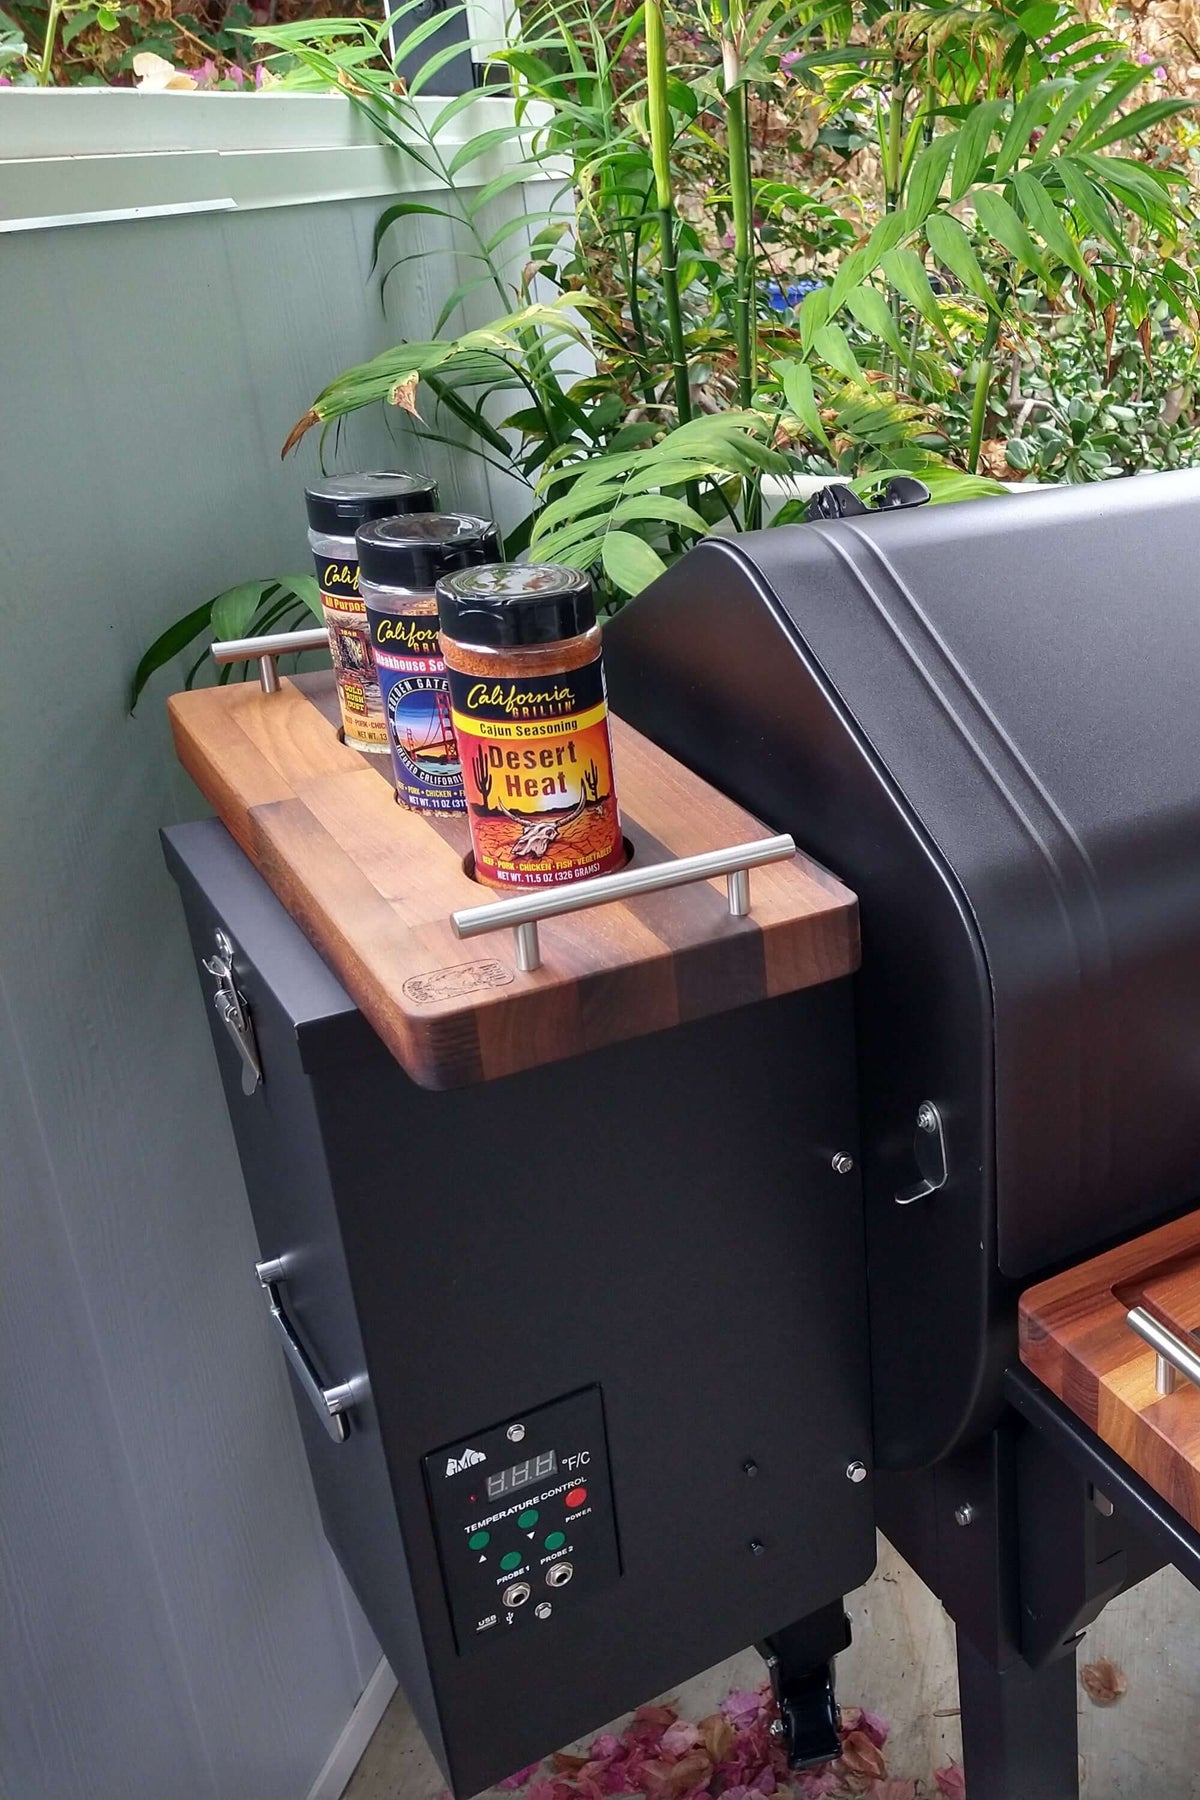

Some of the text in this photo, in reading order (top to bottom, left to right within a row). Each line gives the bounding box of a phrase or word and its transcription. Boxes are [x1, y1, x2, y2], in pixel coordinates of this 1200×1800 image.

[324, 564, 361, 590] Calif
[334, 598, 366, 612] Purpos
[377, 620, 439, 648] Califor
[388, 678, 448, 711] GOLDEN GATE
[467, 684, 576, 713] California
[480, 720, 578, 737] Cajun Seasoning
[488, 741, 577, 770] Desert
[420, 771, 463, 786] CALIFORNI
[505, 771, 567, 797] Heat
[425, 789, 452, 798] CHICKEN
[441, 799, 451, 808] OZ
[497, 860, 515, 870] PORK
[519, 863, 552, 872] CHICKEN
[556, 860, 573, 870] FISH
[497, 870, 509, 880] NET
[525, 873, 541, 883] 11.5
[543, 873, 553, 882] OZ
[555, 870, 573, 881] (326
[574, 863, 600, 878] GRAMS)
[464, 1476, 587, 1534] TEMPERATURE CONTROL
[565, 1507, 592, 1523] POWER
[540, 1548, 570, 1565] PROBE
[496, 1567, 527, 1585] PROBE
[478, 1614, 497, 1627] USB
